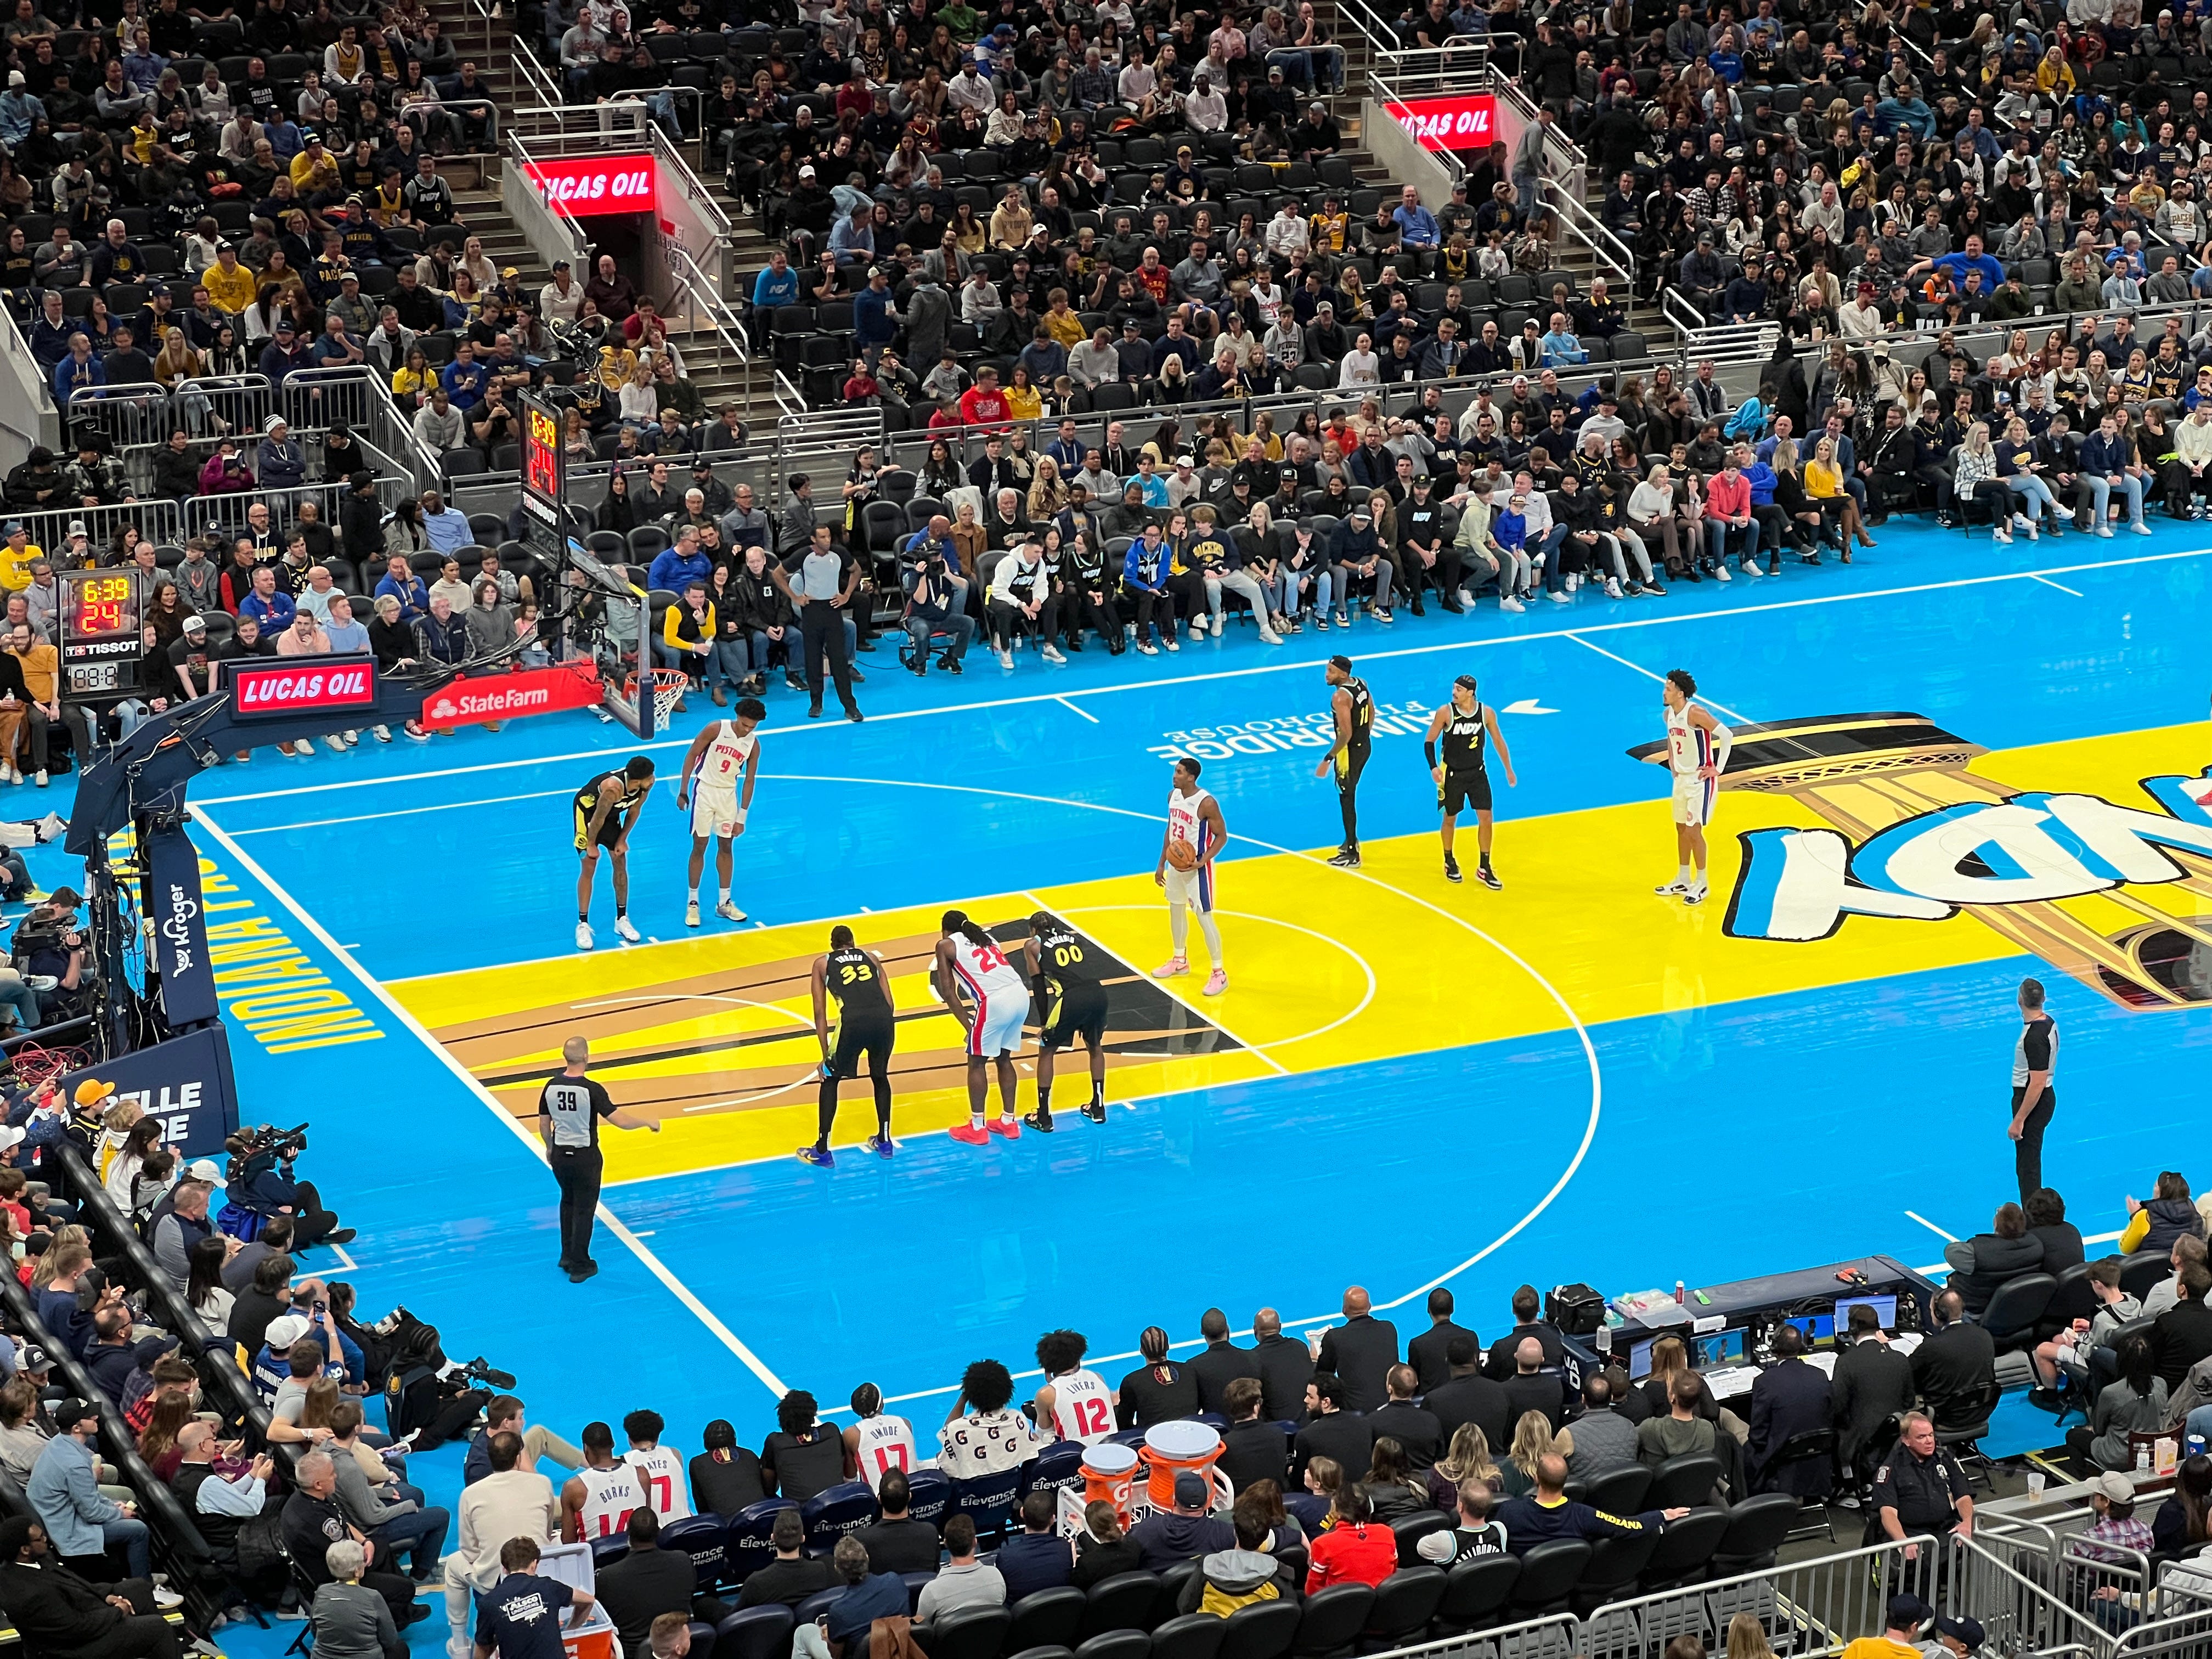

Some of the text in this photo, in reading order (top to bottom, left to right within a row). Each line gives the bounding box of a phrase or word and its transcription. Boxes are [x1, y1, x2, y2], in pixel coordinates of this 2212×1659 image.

[1457, 110, 1489, 134] OIL
[611, 171, 650, 197] OIL
[420, 192, 440, 202] INDY
[529, 438, 555, 496] 24
[1413, 512, 1431, 522] INDY
[83, 578, 128, 603] 6:39
[81, 603, 120, 633] 24
[85, 640, 139, 654] TISSOT
[244, 672, 365, 703] LUCAS OIL
[1453, 722, 1482, 735] INDY
[1469, 736, 1479, 750] 2
[1676, 741, 1683, 755] 2
[715, 744, 745, 762] PISTONS
[721, 760, 731, 773] 9
[1172, 822, 1185, 840] 23
[163, 883, 198, 947] Kroger
[972, 945, 1011, 973] 28
[1054, 945, 1084, 967] 00
[839, 964, 873, 985] 33
[206, 916, 387, 1055] INDIANA
[557, 1091, 577, 1111] 39
[256, 1364, 283, 1387] MANNING
[1066, 1381, 1095, 1394] LIVERS
[1073, 1398, 1110, 1437] 12
[871, 1426, 898, 1440] UMUDE
[646, 1459, 668, 1471] AYES
[874, 1443, 909, 1475] 17
[600, 1486, 630, 1503] BURKS
[961, 1487, 1017, 1506] Elevance
[988, 1494, 1015, 1509] Health
[1114, 1482, 1129, 1503] G
[909, 1500, 945, 1514] vance
[916, 1506, 943, 1520] Health
[814, 1514, 872, 1532] Elevance
[1595, 1510, 1643, 1530] INDIANA
[693, 1553, 723, 1566] Health
[510, 1595, 539, 1611] ALSCO
